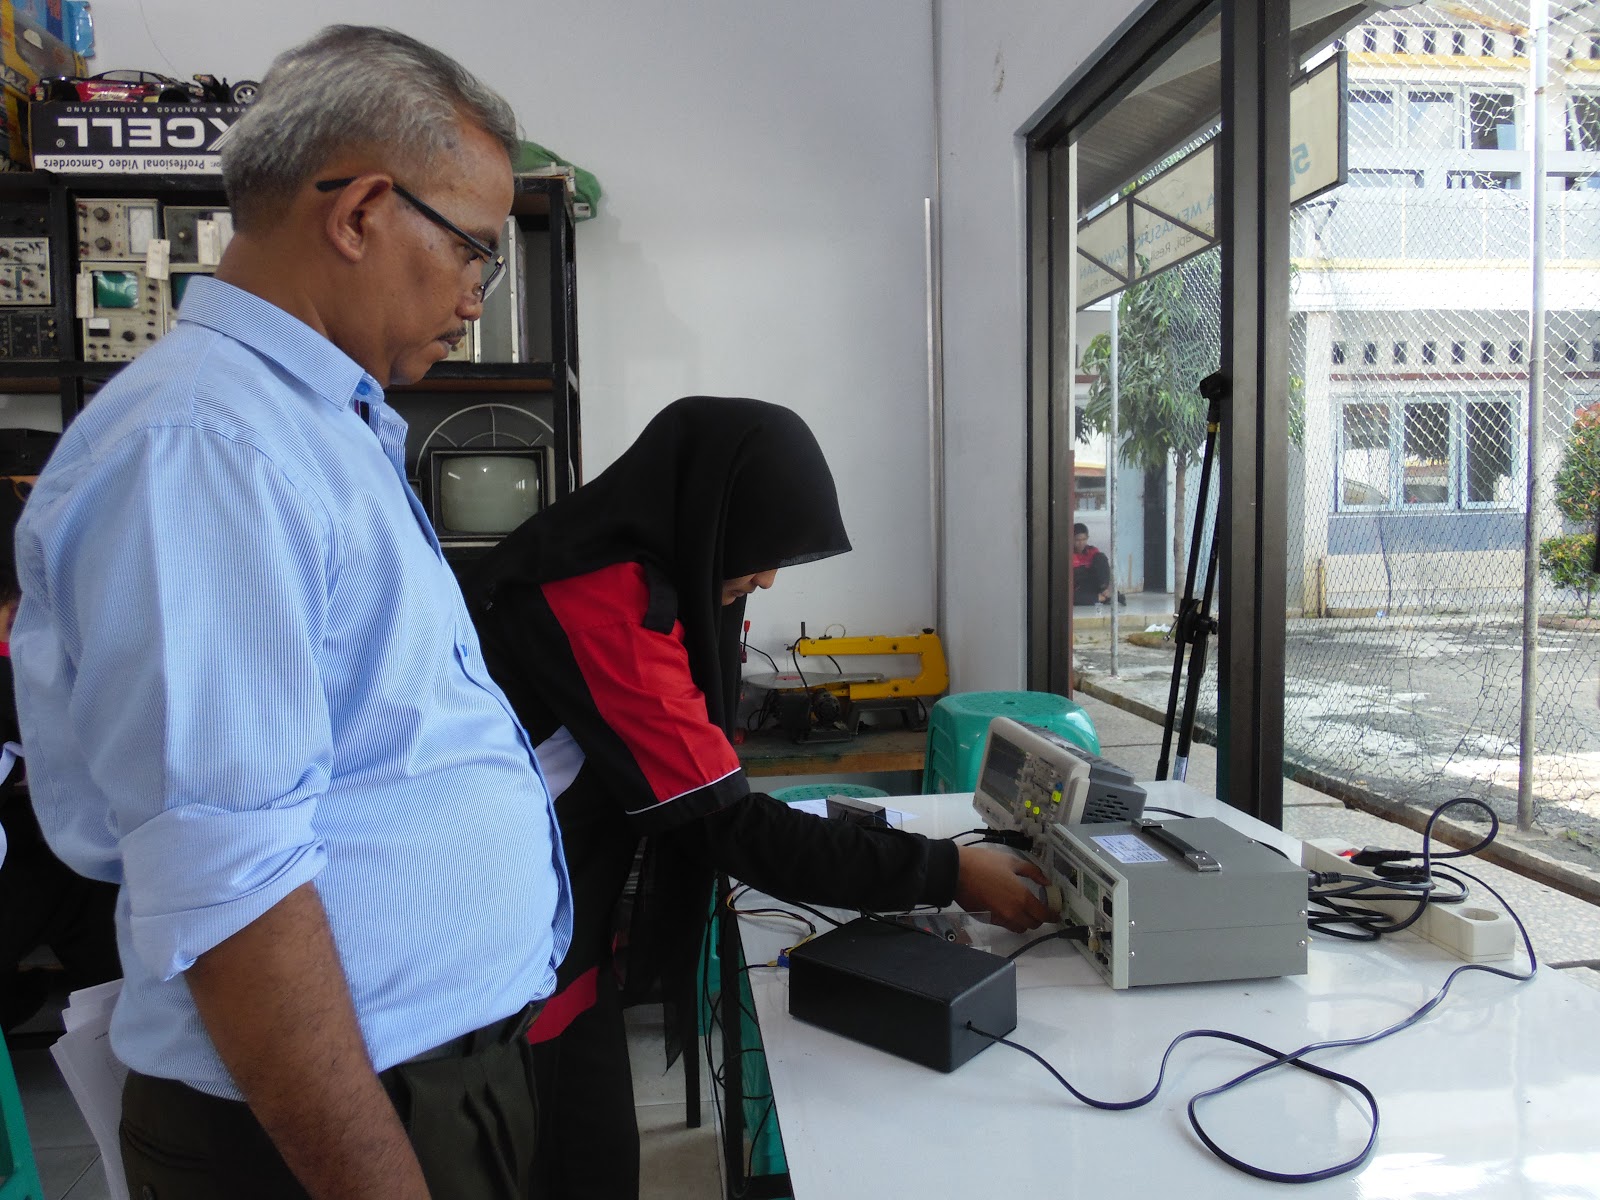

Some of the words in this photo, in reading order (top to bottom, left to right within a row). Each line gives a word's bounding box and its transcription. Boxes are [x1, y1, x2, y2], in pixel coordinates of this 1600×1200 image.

[57, 117, 239, 151] XCELL
[43, 159, 104, 170] Camcorders
[109, 159, 139, 170] Video
[143, 159, 205, 170] Proffesional
